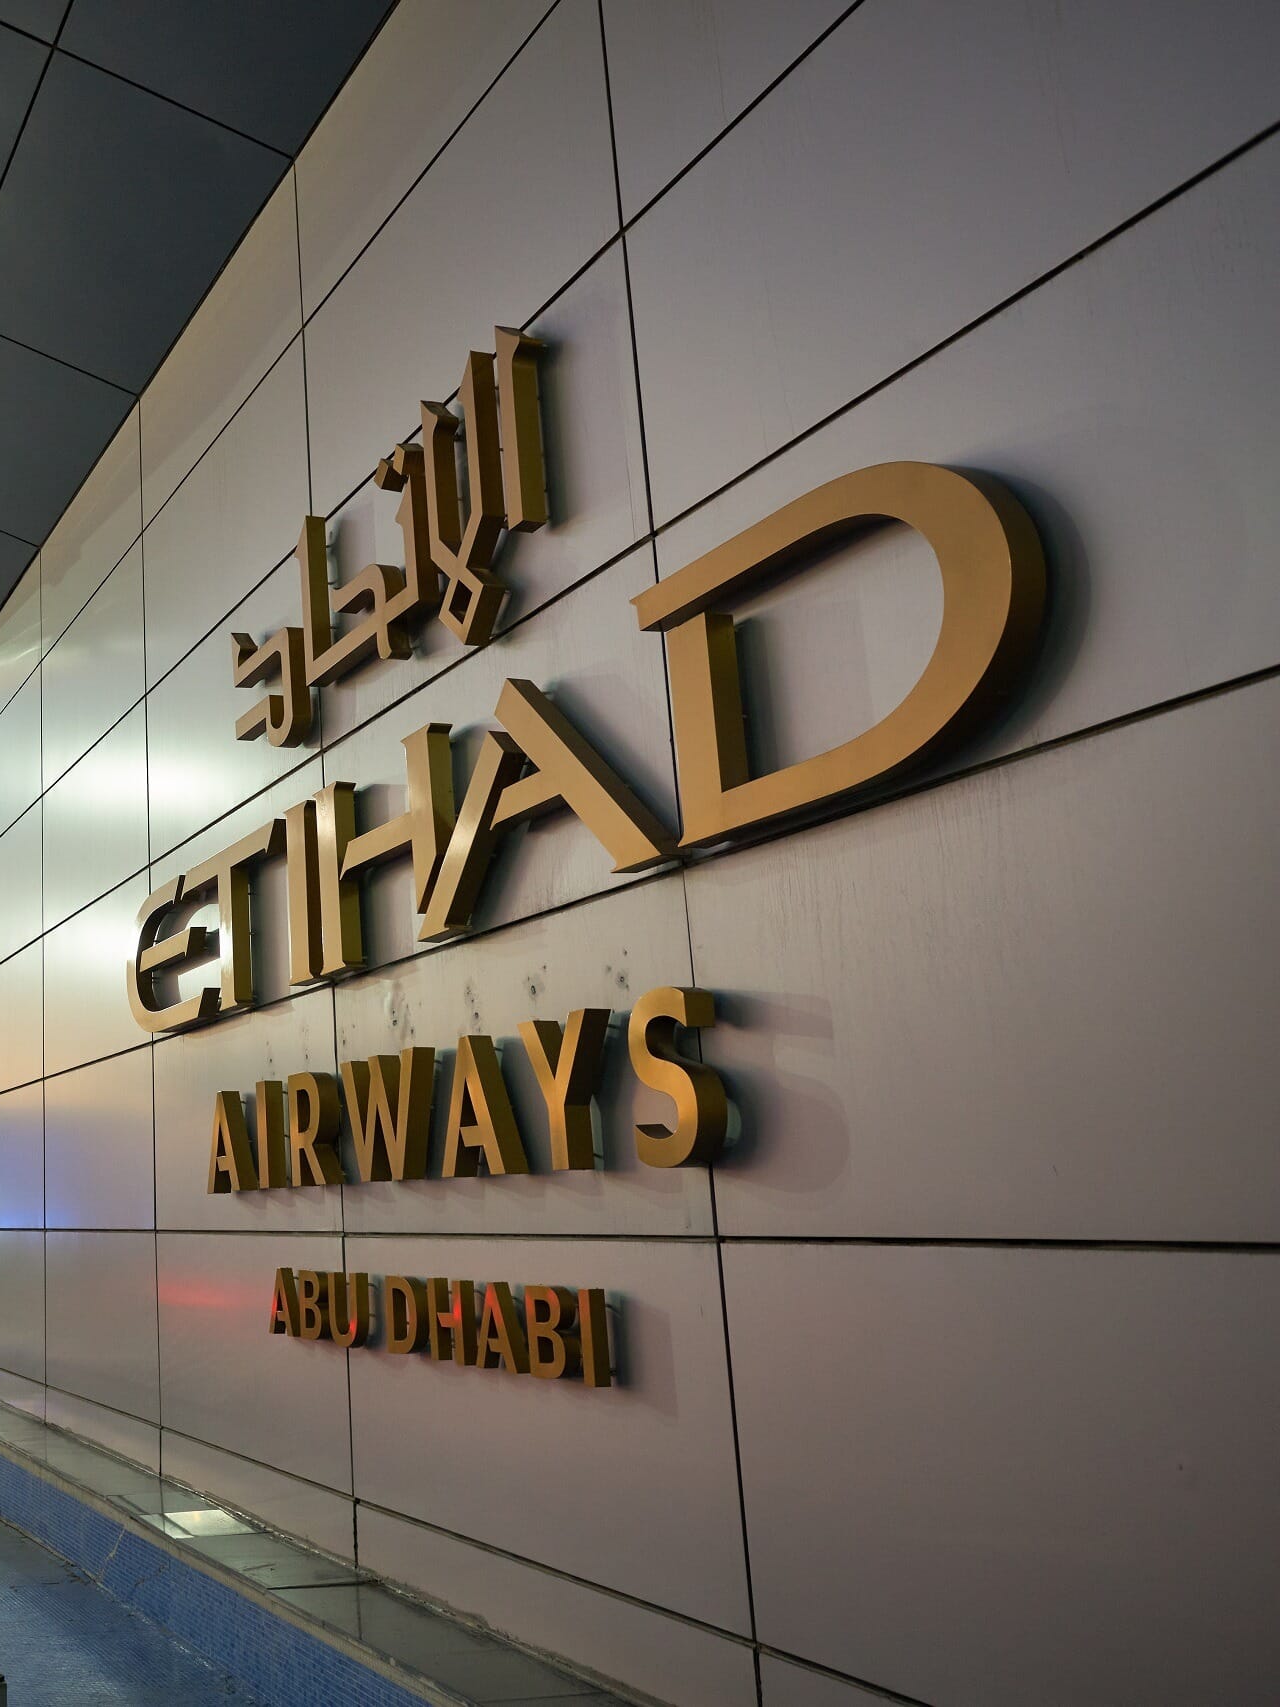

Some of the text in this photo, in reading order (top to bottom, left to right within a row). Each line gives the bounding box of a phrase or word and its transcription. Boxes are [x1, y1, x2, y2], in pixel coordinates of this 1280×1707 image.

[127, 461, 1047, 1033] ETIHAD
[207, 986, 728, 1194] AIRWAYS
[269, 1267, 614, 1388] ABU DHABI
